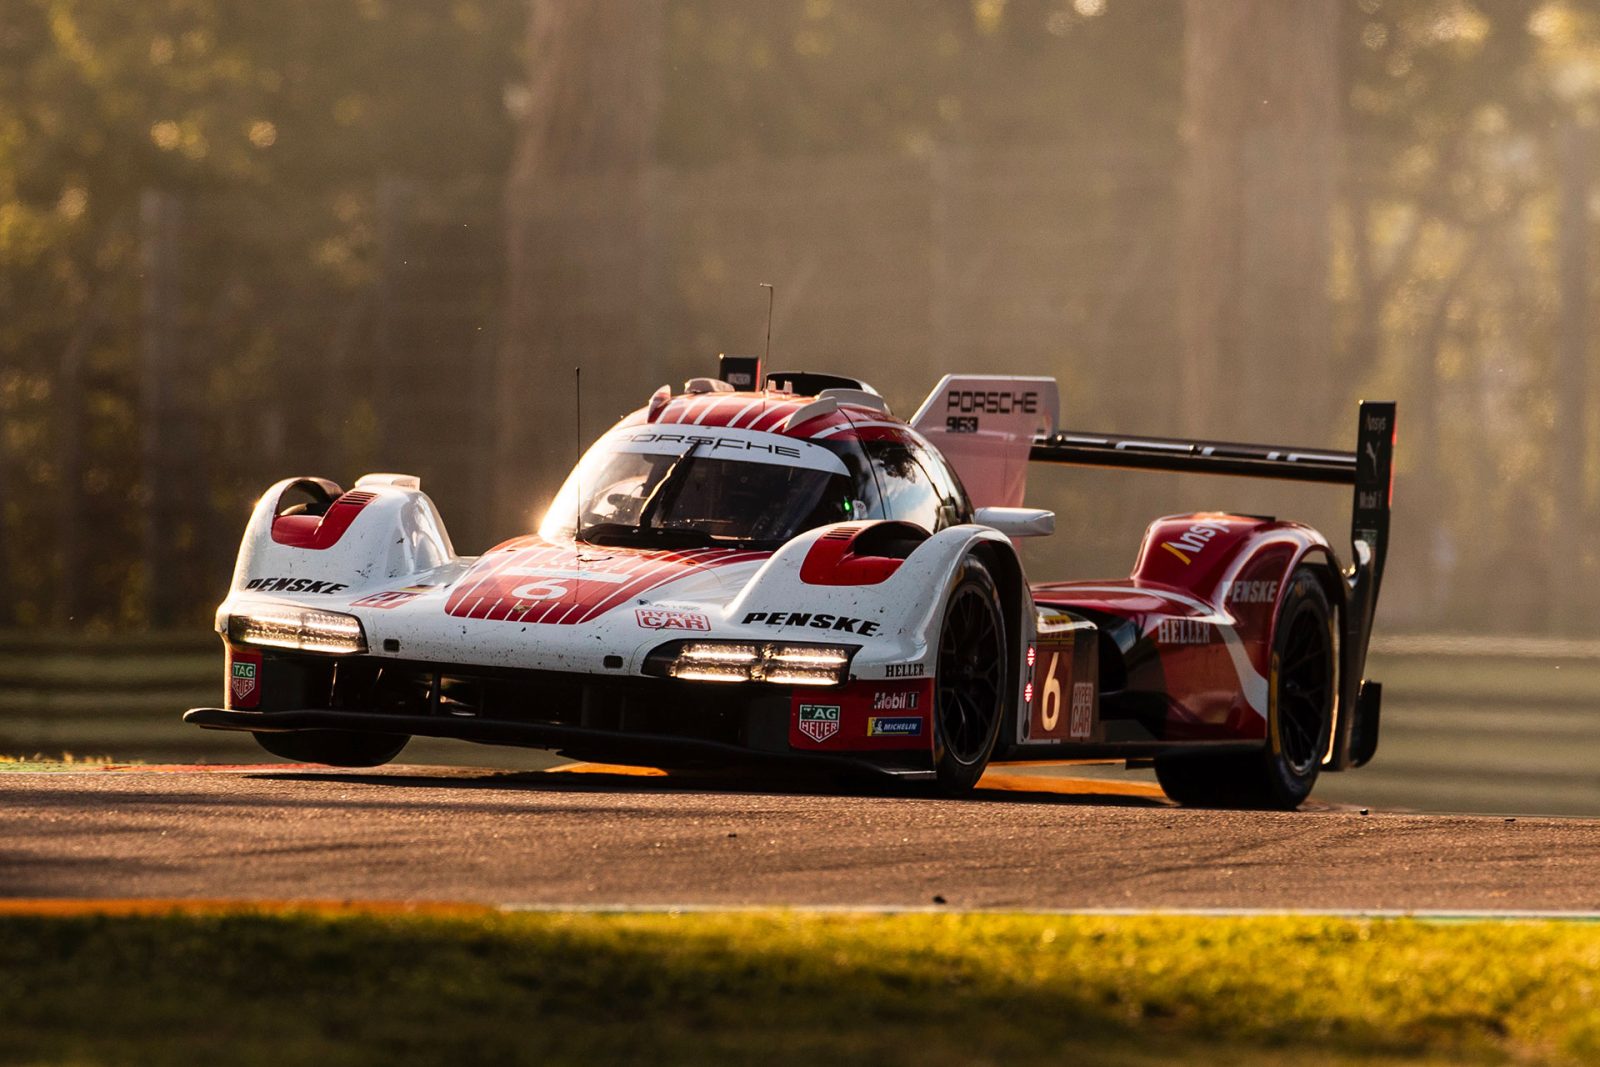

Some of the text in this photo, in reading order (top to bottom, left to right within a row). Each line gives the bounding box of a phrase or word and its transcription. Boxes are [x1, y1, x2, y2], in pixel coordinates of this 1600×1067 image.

[947, 391, 1038, 414] PORSCHE
[946, 416, 979, 433] 963
[244, 577, 350, 595] PENSKE
[511, 578, 568, 600] 6
[642, 616, 705, 630] CAR
[741, 611, 881, 637] PENSKE
[1157, 618, 1211, 644] HELLER
[233, 664, 254, 678] TAG
[885, 663, 925, 678] HELLER
[874, 692, 907, 709] Mobil
[1041, 651, 1061, 732] 6
[882, 722, 919, 731] MICHELIN
[1072, 704, 1091, 734] CAR
[801, 721, 838, 740] HEUER
